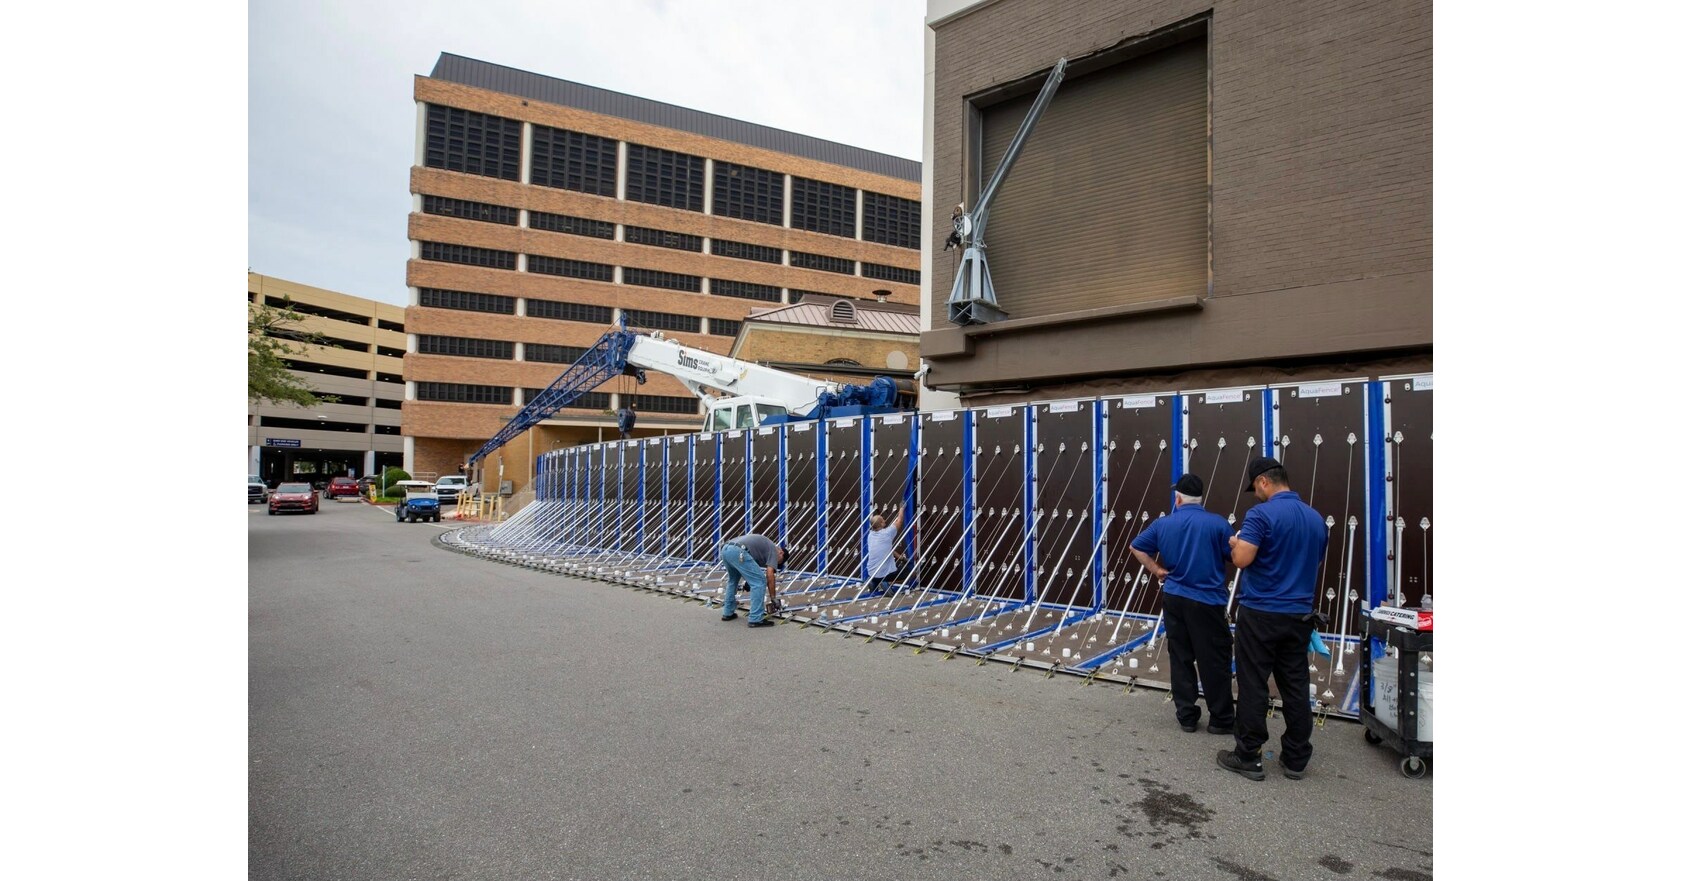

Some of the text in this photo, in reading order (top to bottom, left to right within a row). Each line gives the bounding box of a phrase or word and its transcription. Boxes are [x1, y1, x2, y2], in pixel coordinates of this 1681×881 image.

[678, 349, 698, 370] Sims
[1300, 387, 1339, 395] AquaFence
[1207, 394, 1241, 402] AquaFence
[1390, 611, 1415, 620] CATERING
